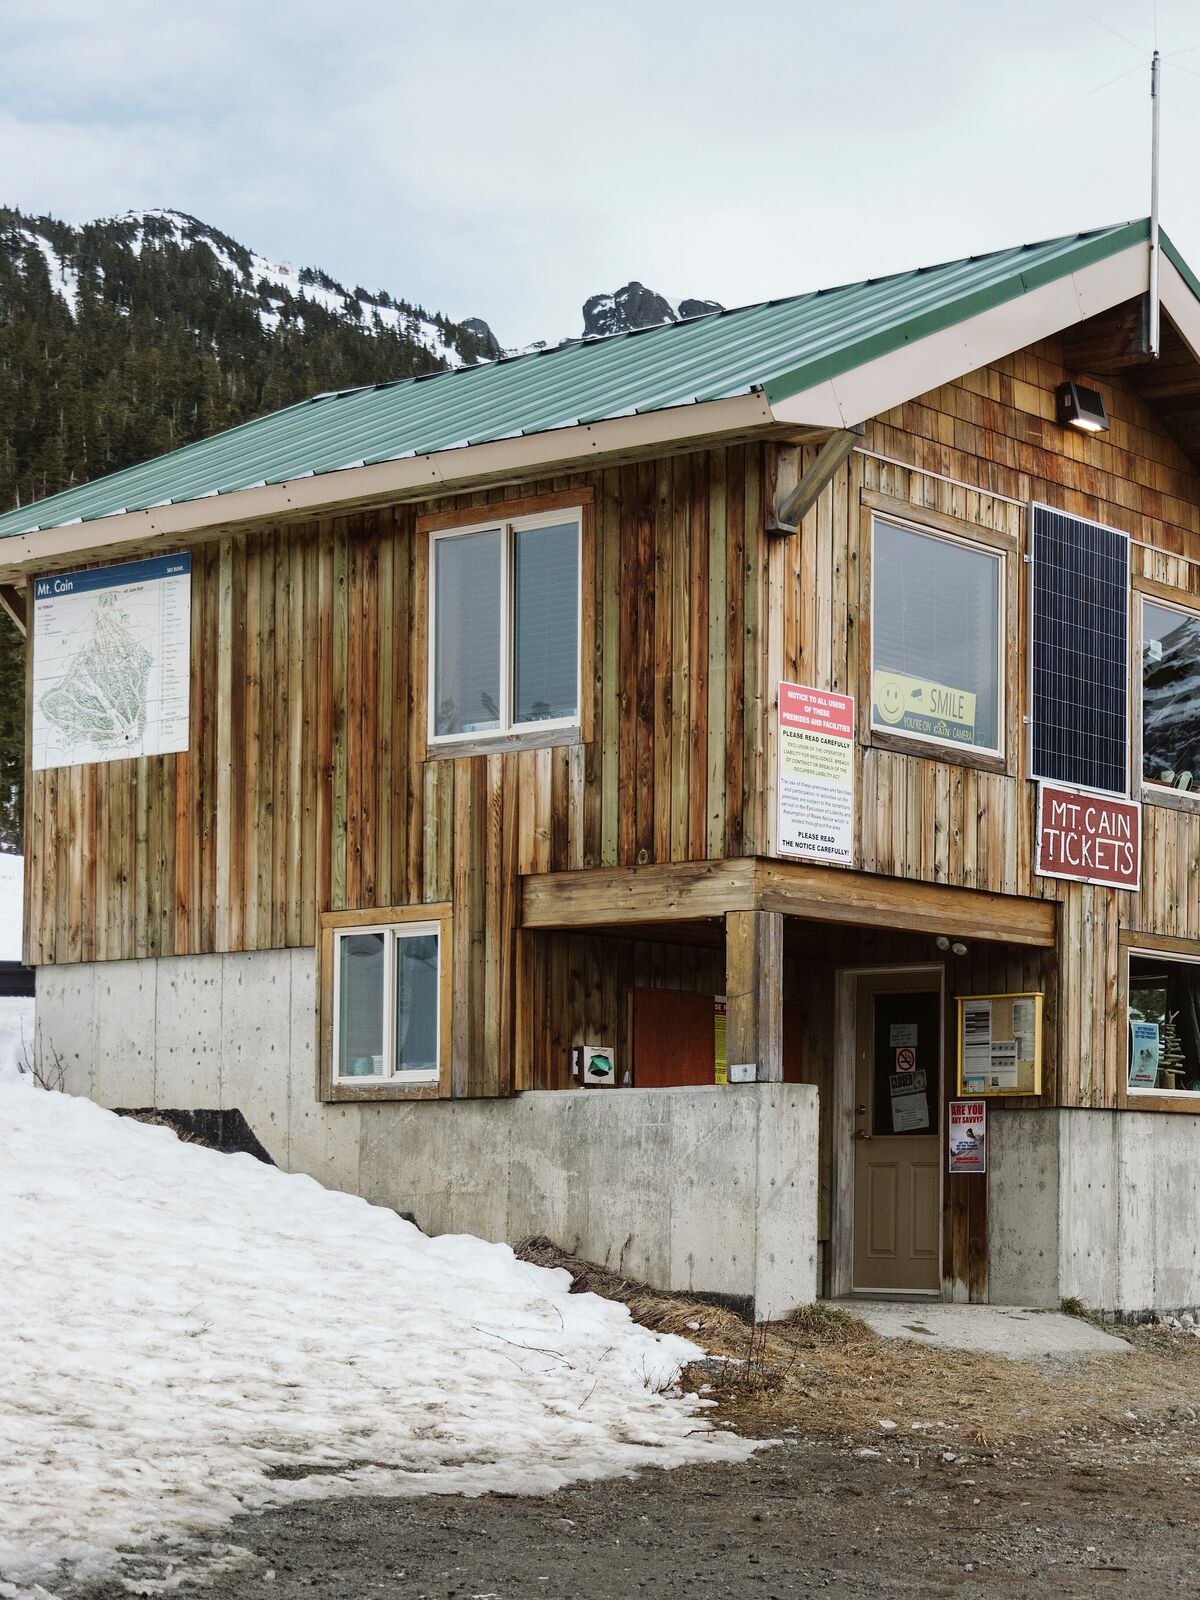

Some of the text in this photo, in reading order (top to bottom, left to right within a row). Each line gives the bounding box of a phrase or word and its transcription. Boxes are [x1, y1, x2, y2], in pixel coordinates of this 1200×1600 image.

[38, 580, 73, 596] Mt. Cain
[788, 691, 808, 702] NOTICE
[829, 700, 846, 710] USERS
[930, 688, 964, 719] SMILE
[813, 708, 830, 717] THESE
[783, 712, 810, 724] PREMISES
[823, 721, 850, 732] FACILITIES
[904, 716, 971, 741] YOU'RE ON CAIN CAMERA
[783, 730, 803, 739] PLEASE
[820, 738, 850, 748] CAREFULLY
[788, 742, 808, 750] EXCLUSION
[792, 758, 812, 766] CONTRACT
[1052, 800, 1130, 839] MT. CAIN
[798, 832, 819, 840] PLEASE
[795, 842, 815, 850] NOTICE
[817, 845, 849, 856] CAREFULLY!
[1044, 828, 1134, 874] TICKETS
[891, 1074, 912, 1089] CLOSED
[952, 1105, 982, 1115] ARE YOU
